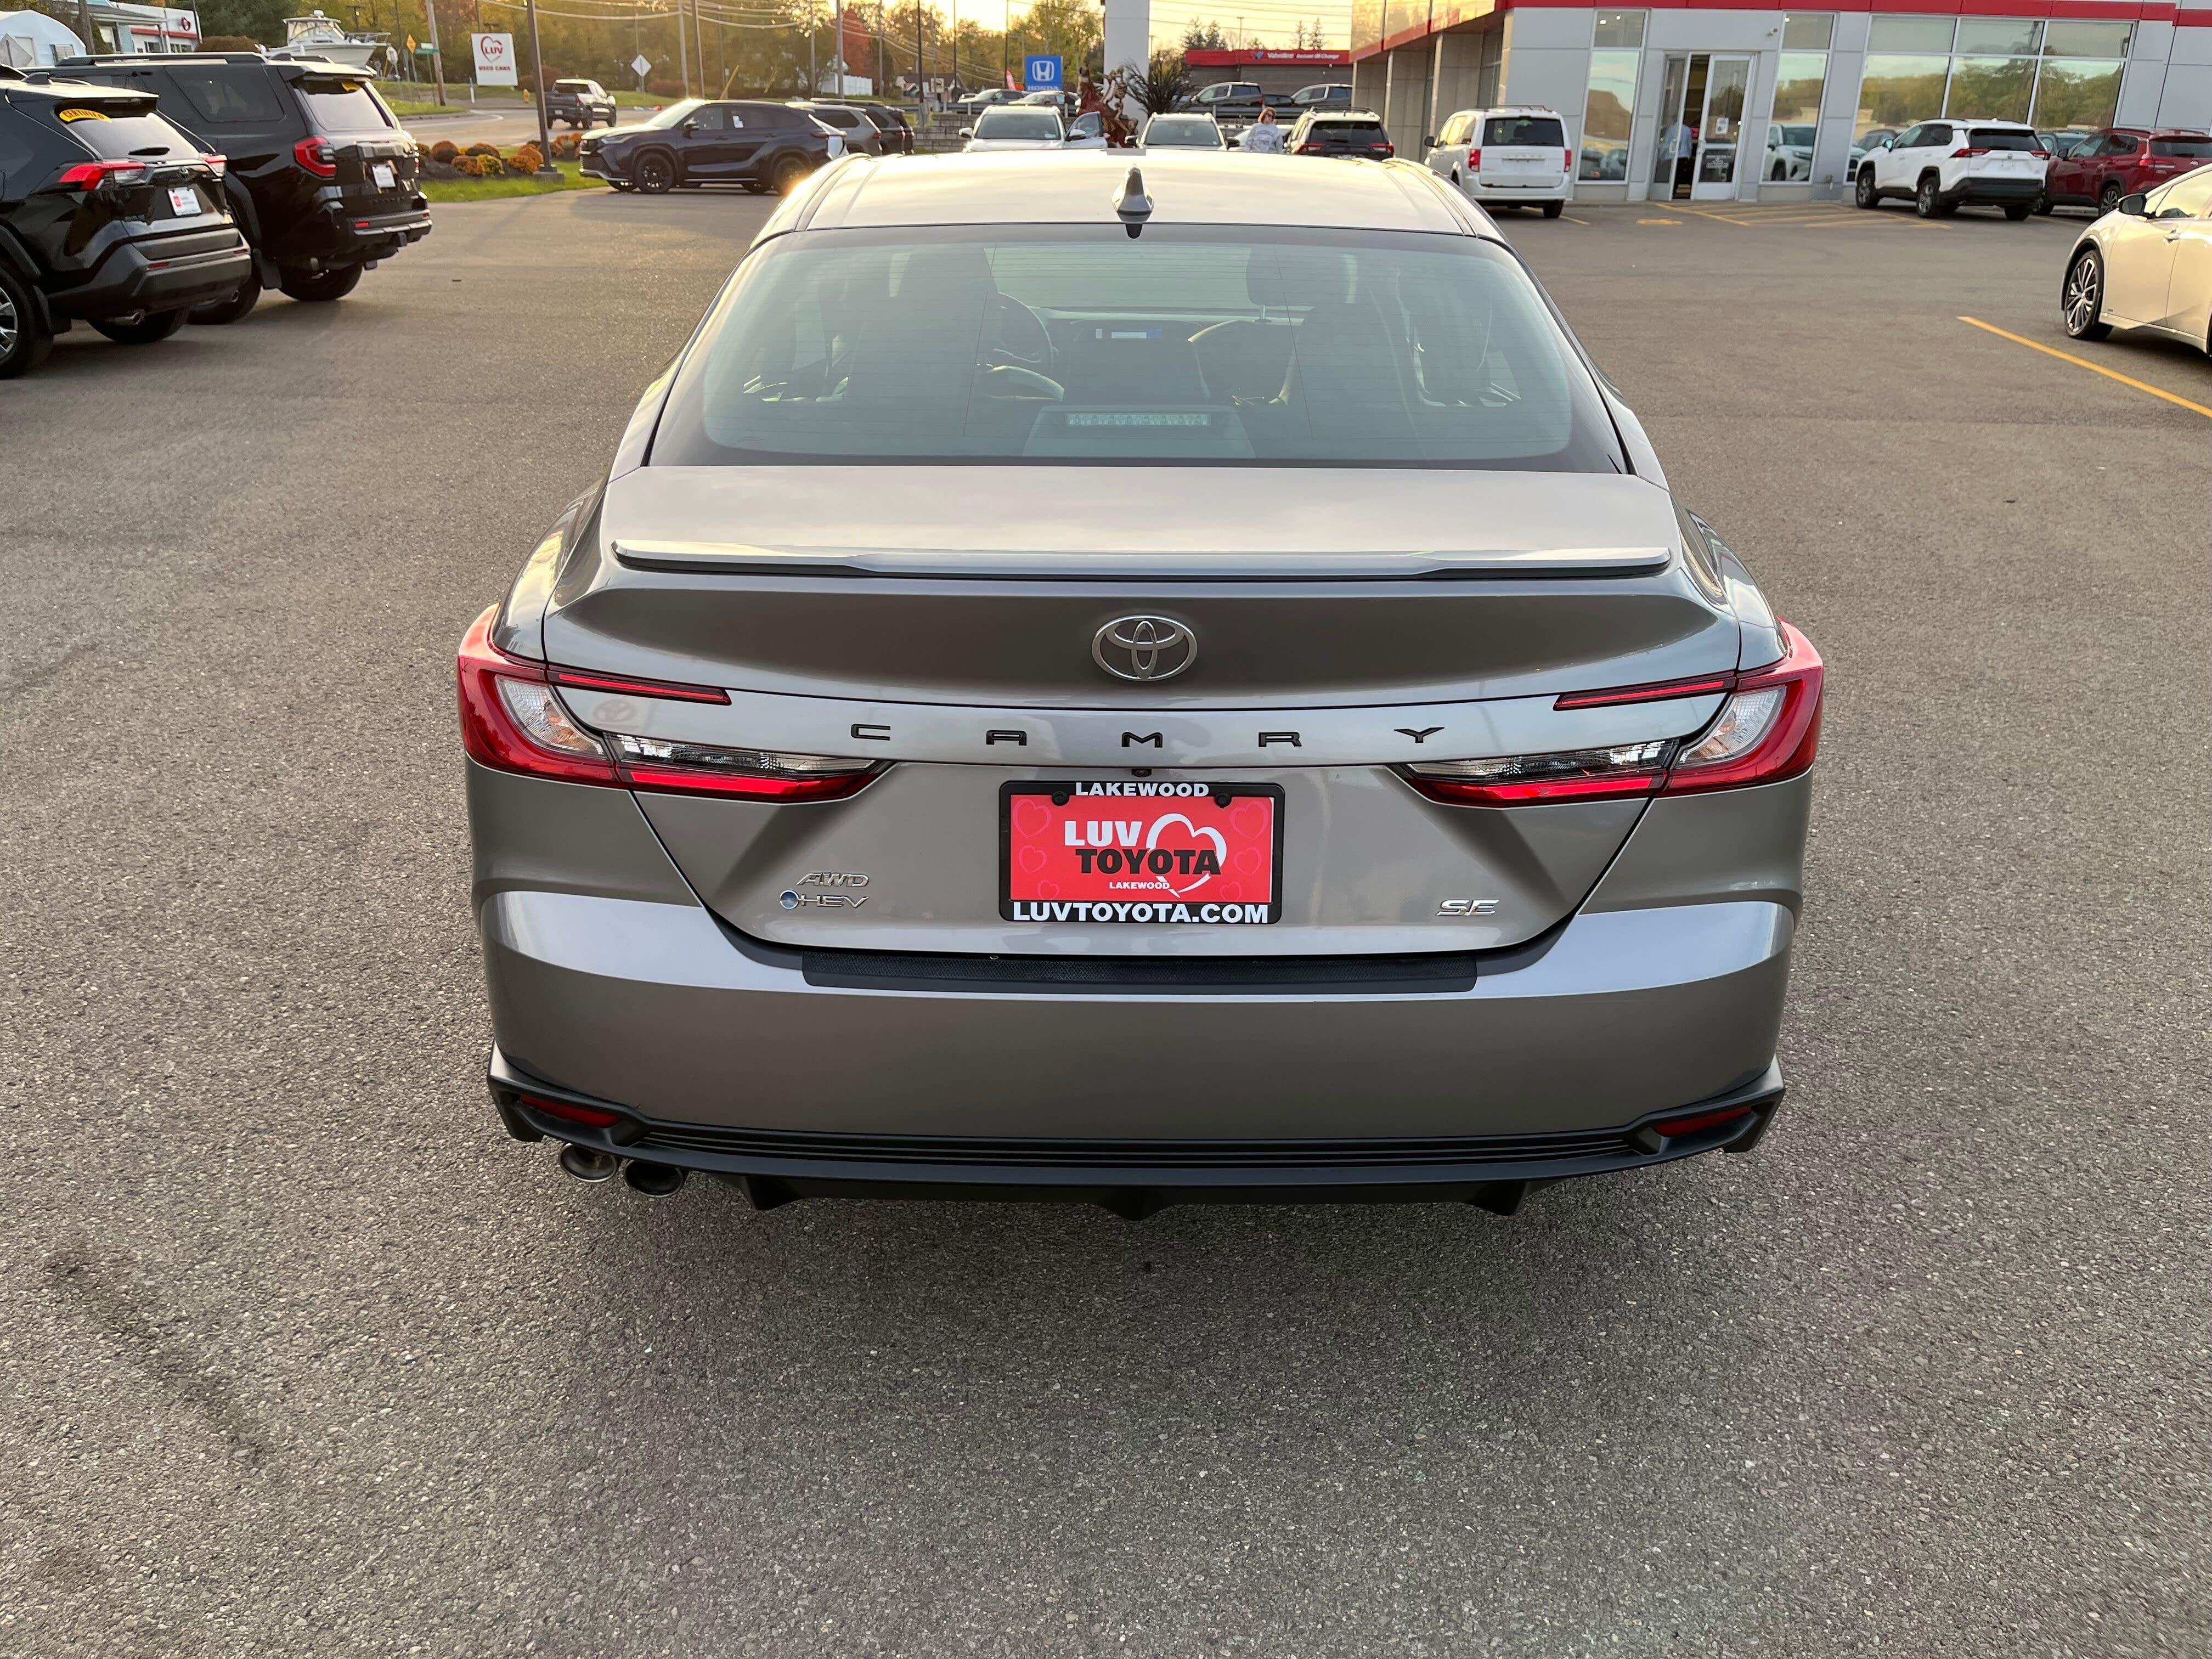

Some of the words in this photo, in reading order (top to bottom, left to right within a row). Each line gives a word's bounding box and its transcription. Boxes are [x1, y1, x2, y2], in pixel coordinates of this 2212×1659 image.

[850, 724, 1445, 748] CAMRY
[1076, 782, 1209, 797] LAKEWOOD
[1064, 820, 1142, 847] LUV
[1075, 849, 1221, 875] TOYOTA
[796, 872, 870, 887] AWD
[1109, 881, 1170, 890] LAKEWOOD
[800, 894, 870, 909] HEV
[1436, 899, 1499, 916] SE
[1013, 902, 1268, 923] LUVTOYOTA.COM
